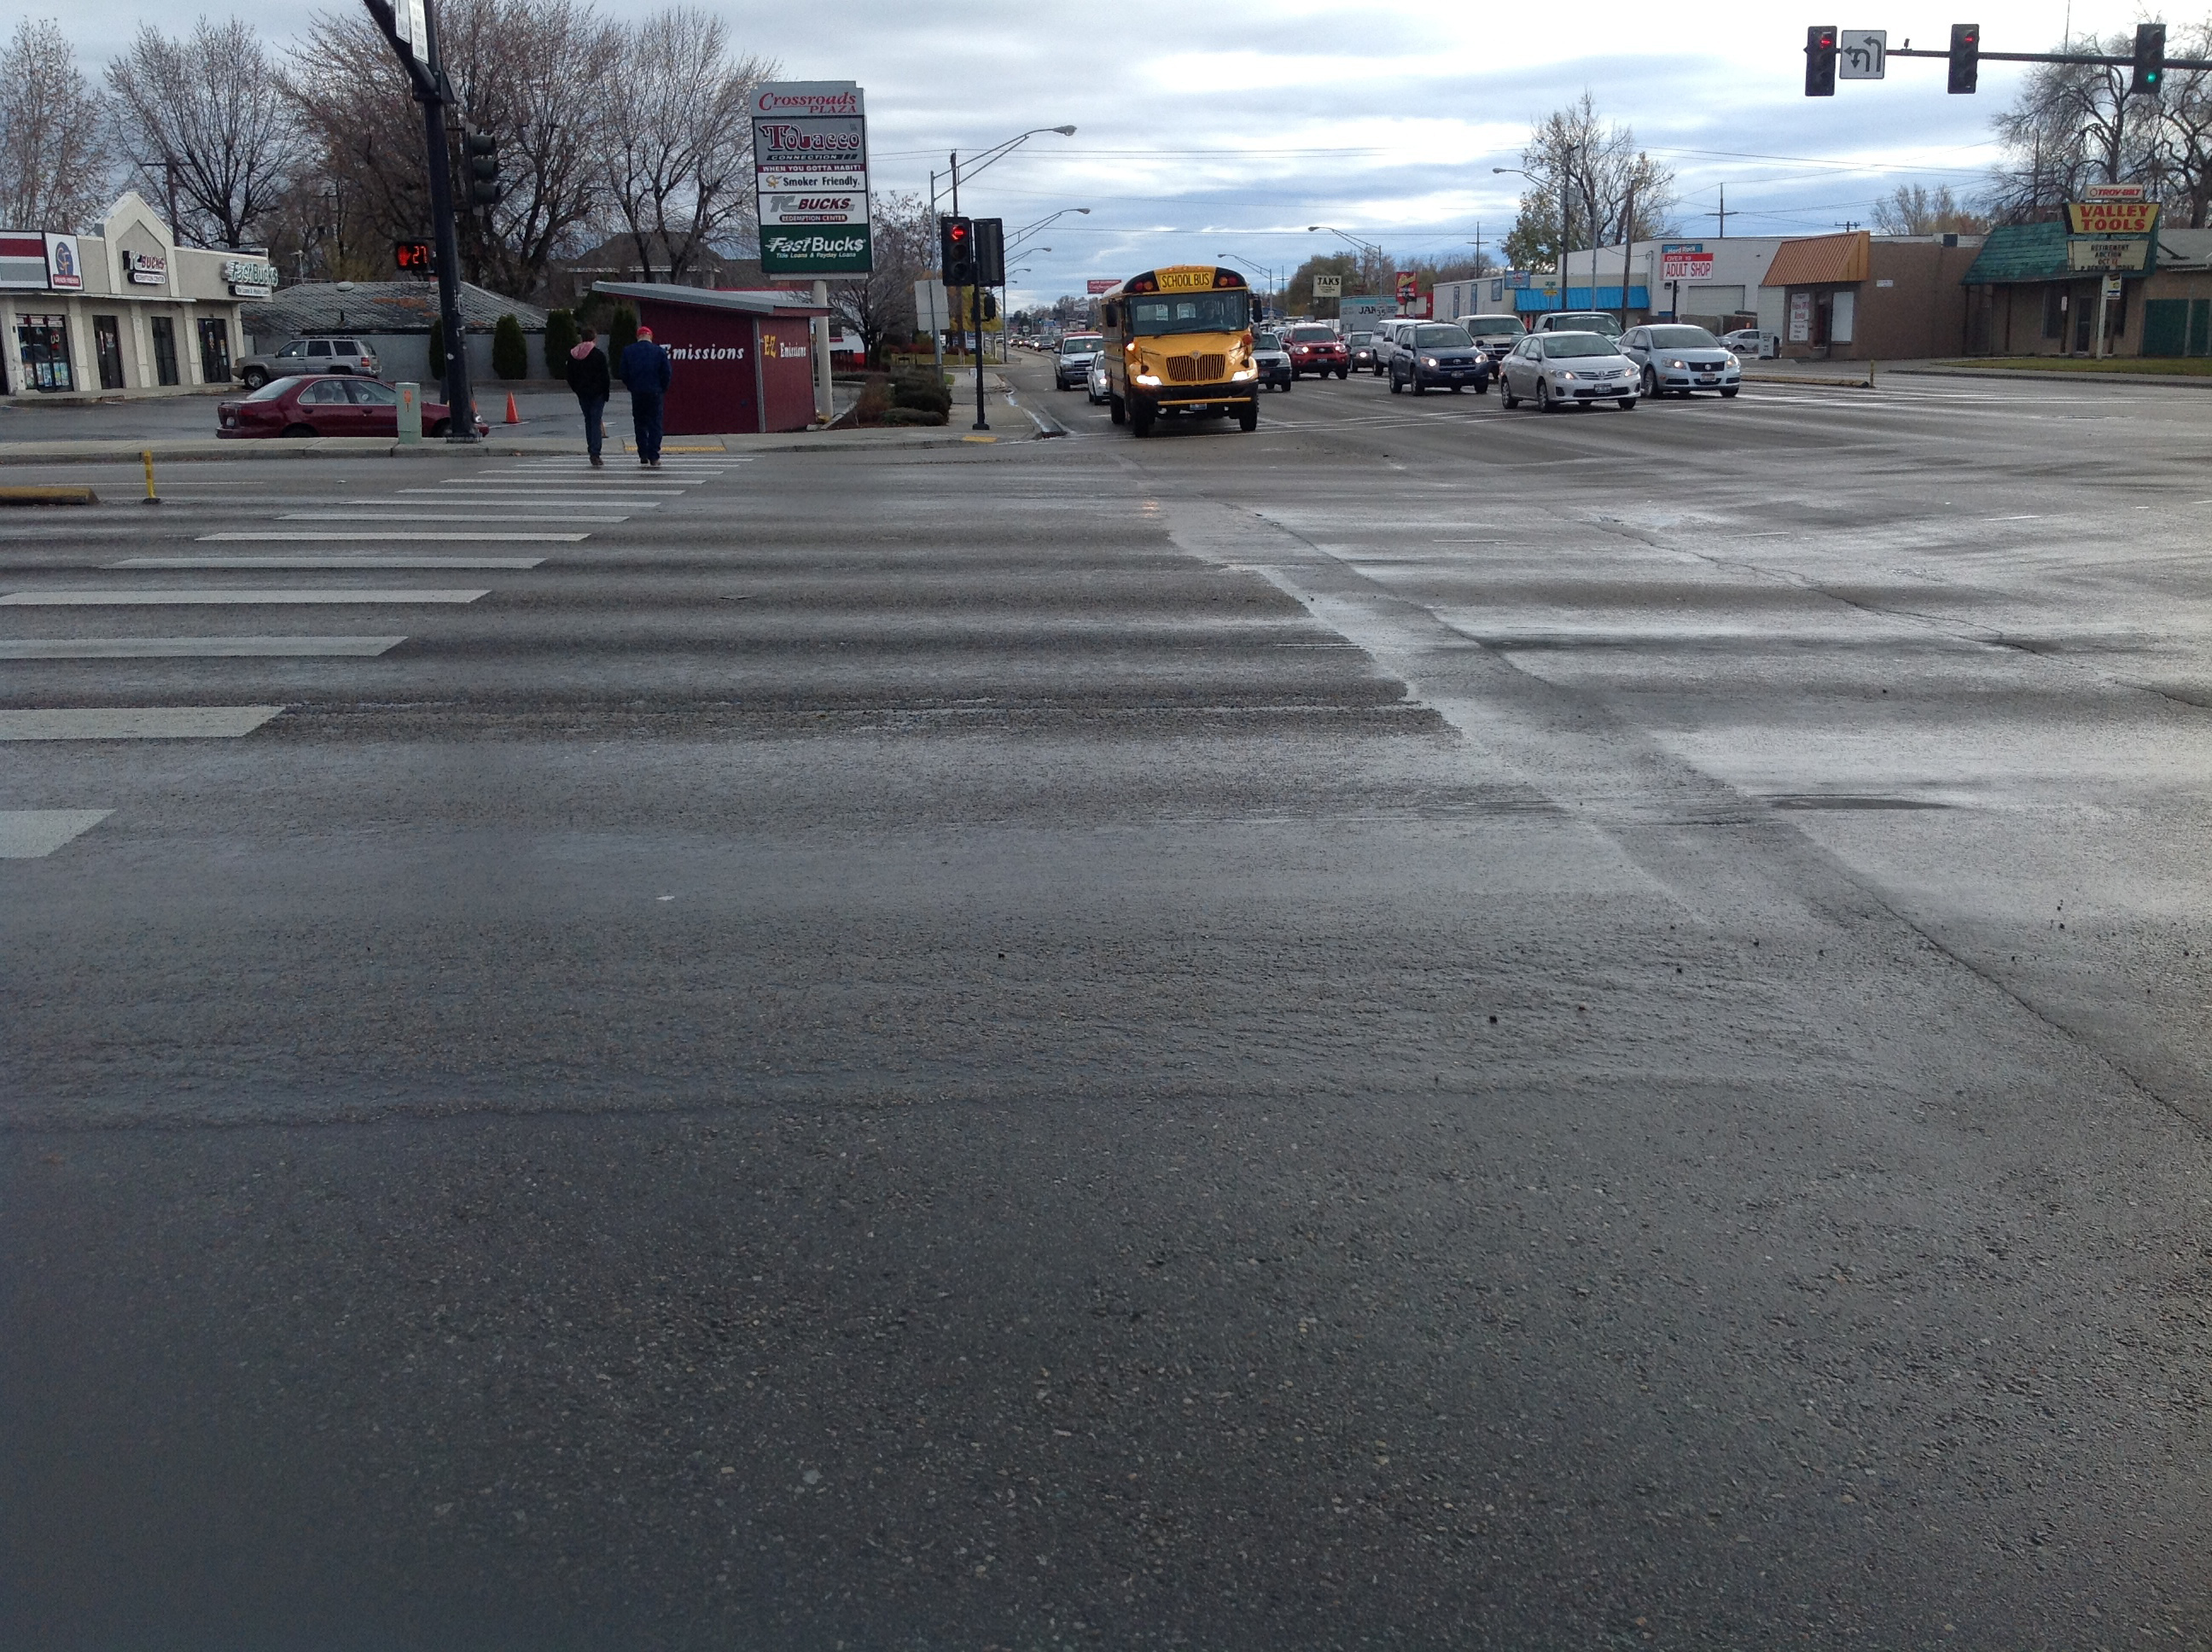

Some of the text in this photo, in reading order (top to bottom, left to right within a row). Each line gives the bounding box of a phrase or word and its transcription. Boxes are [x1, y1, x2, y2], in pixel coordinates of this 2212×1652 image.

[759, 91, 857, 111] Crossroads
[809, 105, 857, 113] PLAZA
[760, 124, 860, 150] Tobacco
[783, 177, 818, 186] Smoker
[798, 198, 852, 210] BUCKS
[2080, 205, 2149, 217] VALLEY
[2081, 218, 2145, 231] TOOLS
[412, 245, 428, 265] 27
[1666, 264, 1688, 277] ADULT
[1691, 262, 1711, 276] SHOP
[1161, 273, 1210, 288] SCHOOL BUS
[1317, 276, 1340, 286] JAKS
[779, 342, 806, 358] Emissions
